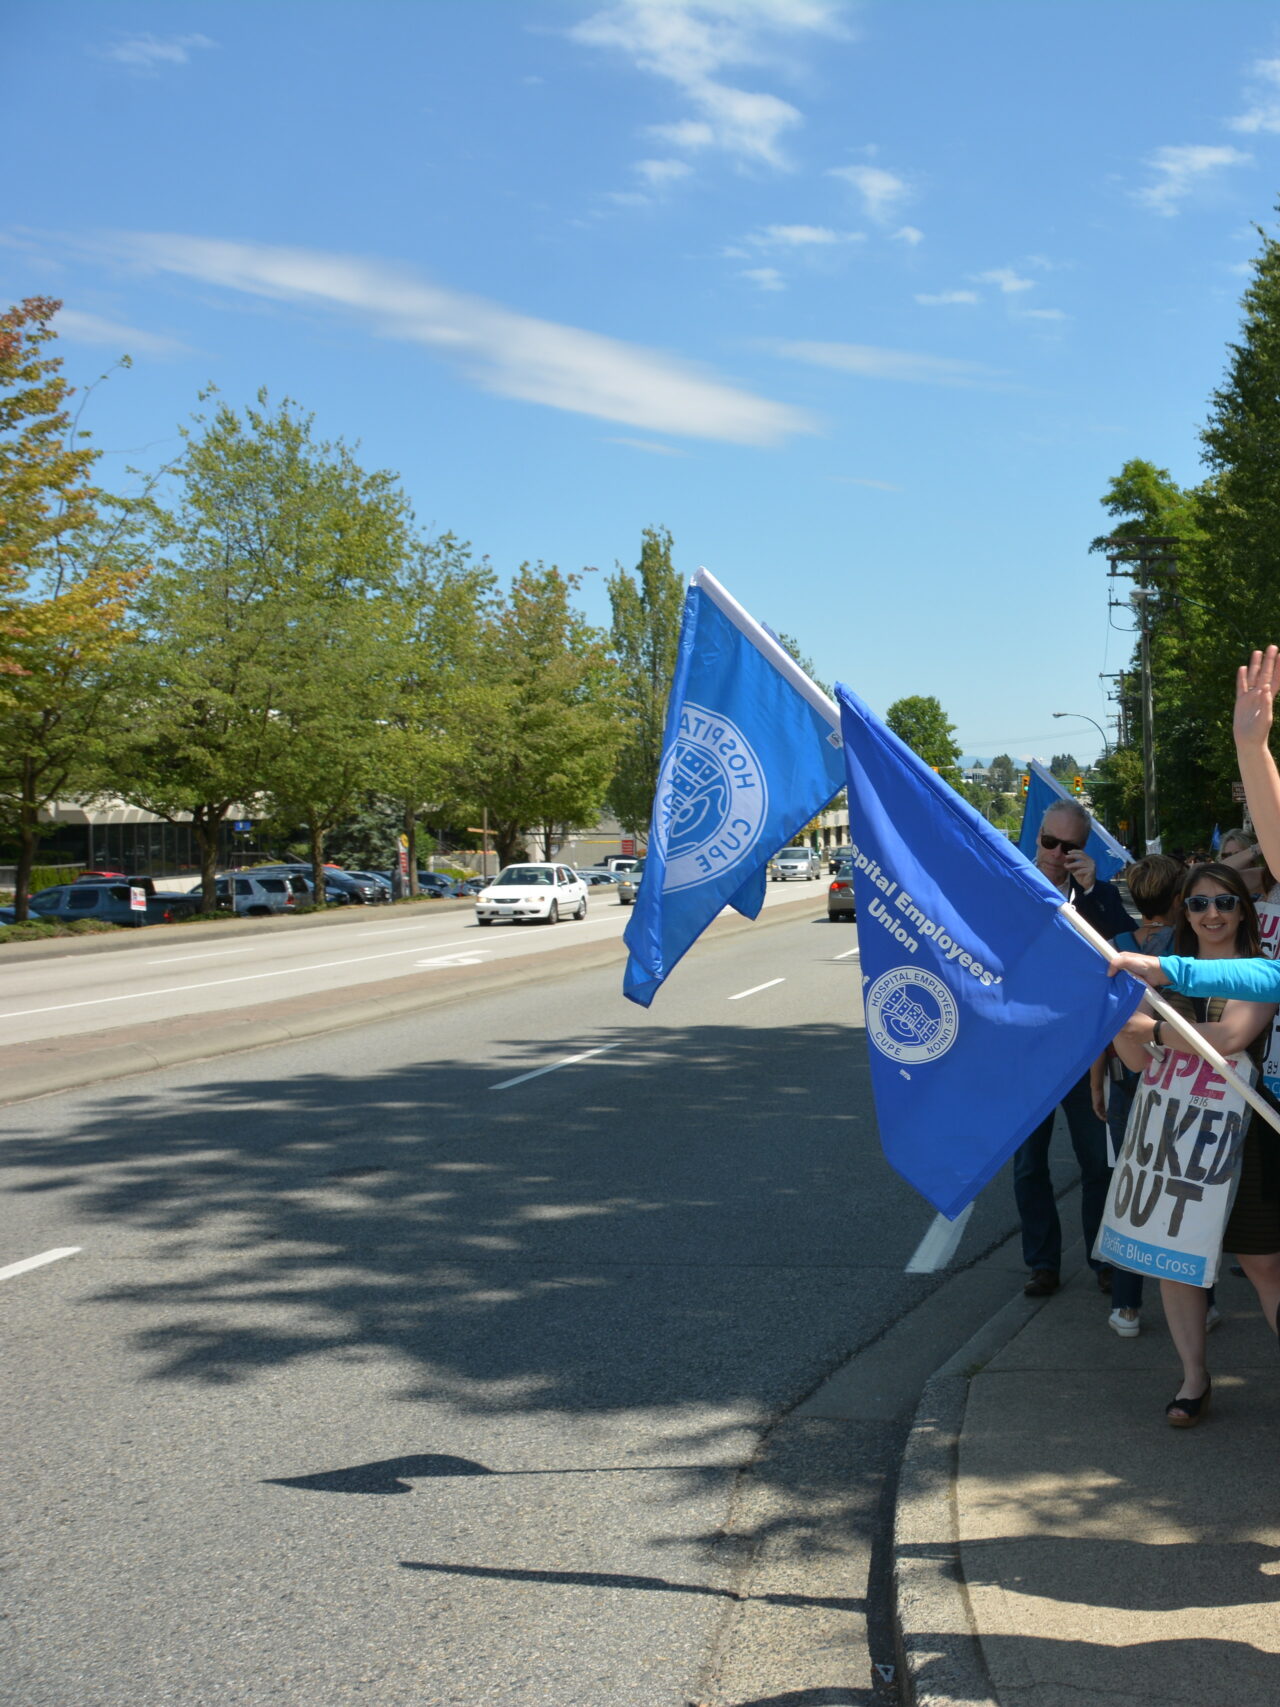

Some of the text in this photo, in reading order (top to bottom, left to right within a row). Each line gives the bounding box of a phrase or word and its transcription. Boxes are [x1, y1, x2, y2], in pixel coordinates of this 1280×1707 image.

[850, 840, 1003, 986] spital Employees'
[867, 897, 919, 953] Union
[871, 972, 912, 1007] HOSPITAL
[926, 1028, 952, 1055] UNION
[875, 1031, 902, 1056] CUPE
[1189, 1094, 1209, 1107] 1816
[1114, 1163, 1204, 1237] OUT
[1126, 1243, 1153, 1267] Blue
[1155, 1254, 1197, 1277] Cross
